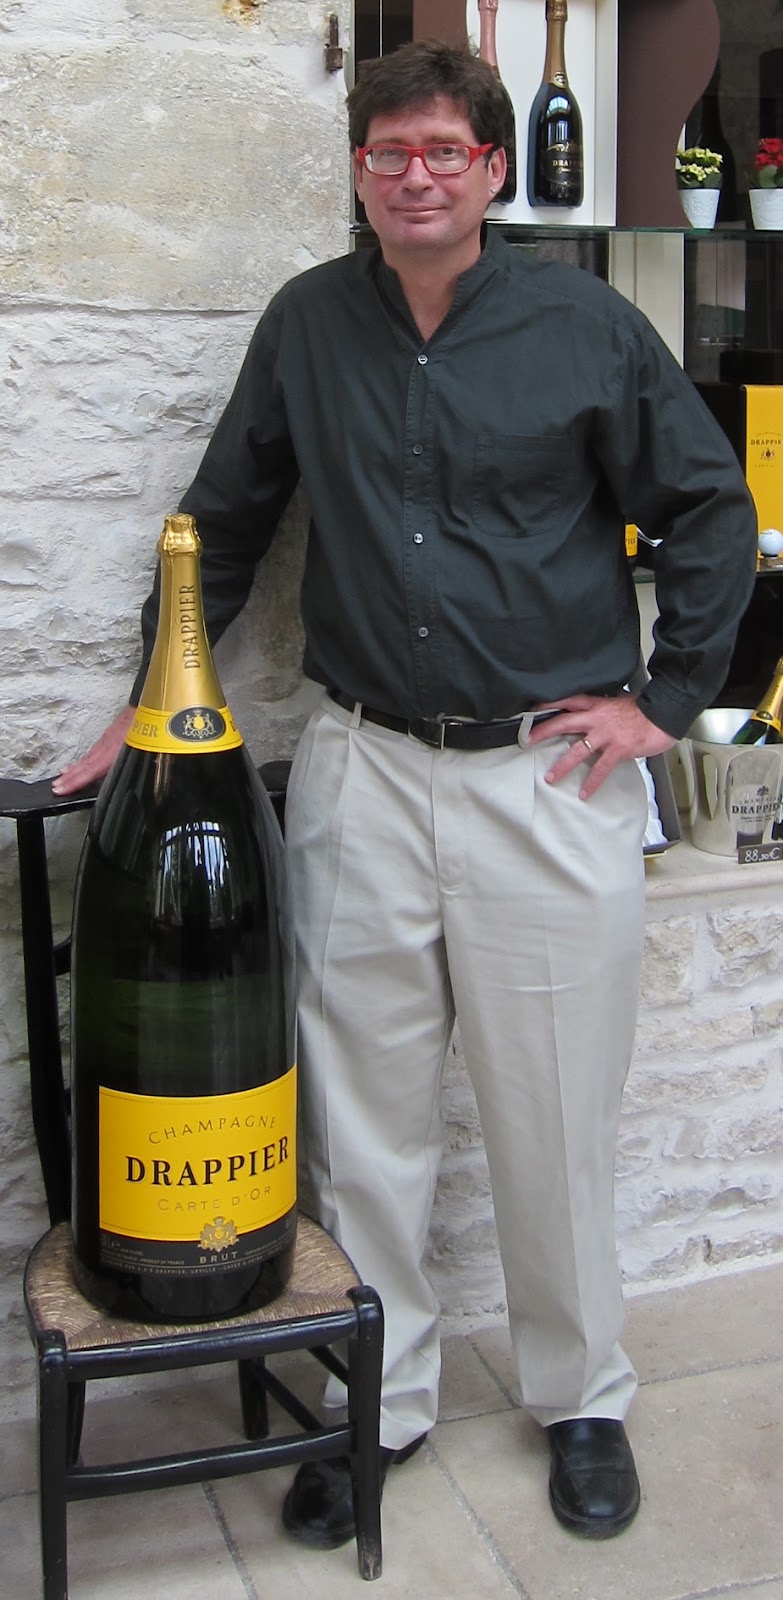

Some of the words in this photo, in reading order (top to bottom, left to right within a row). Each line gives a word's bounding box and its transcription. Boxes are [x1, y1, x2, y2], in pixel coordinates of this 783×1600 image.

[179, 584, 200, 669] DRAPPIER
[148, 1115, 276, 1145] CHAMPAGNE
[125, 1136, 289, 1187] DRAPPIER
[157, 1199, 221, 1212] CARTE
[231, 1185, 272, 1207] D'OR
[199, 1251, 238, 1265] BRUT
